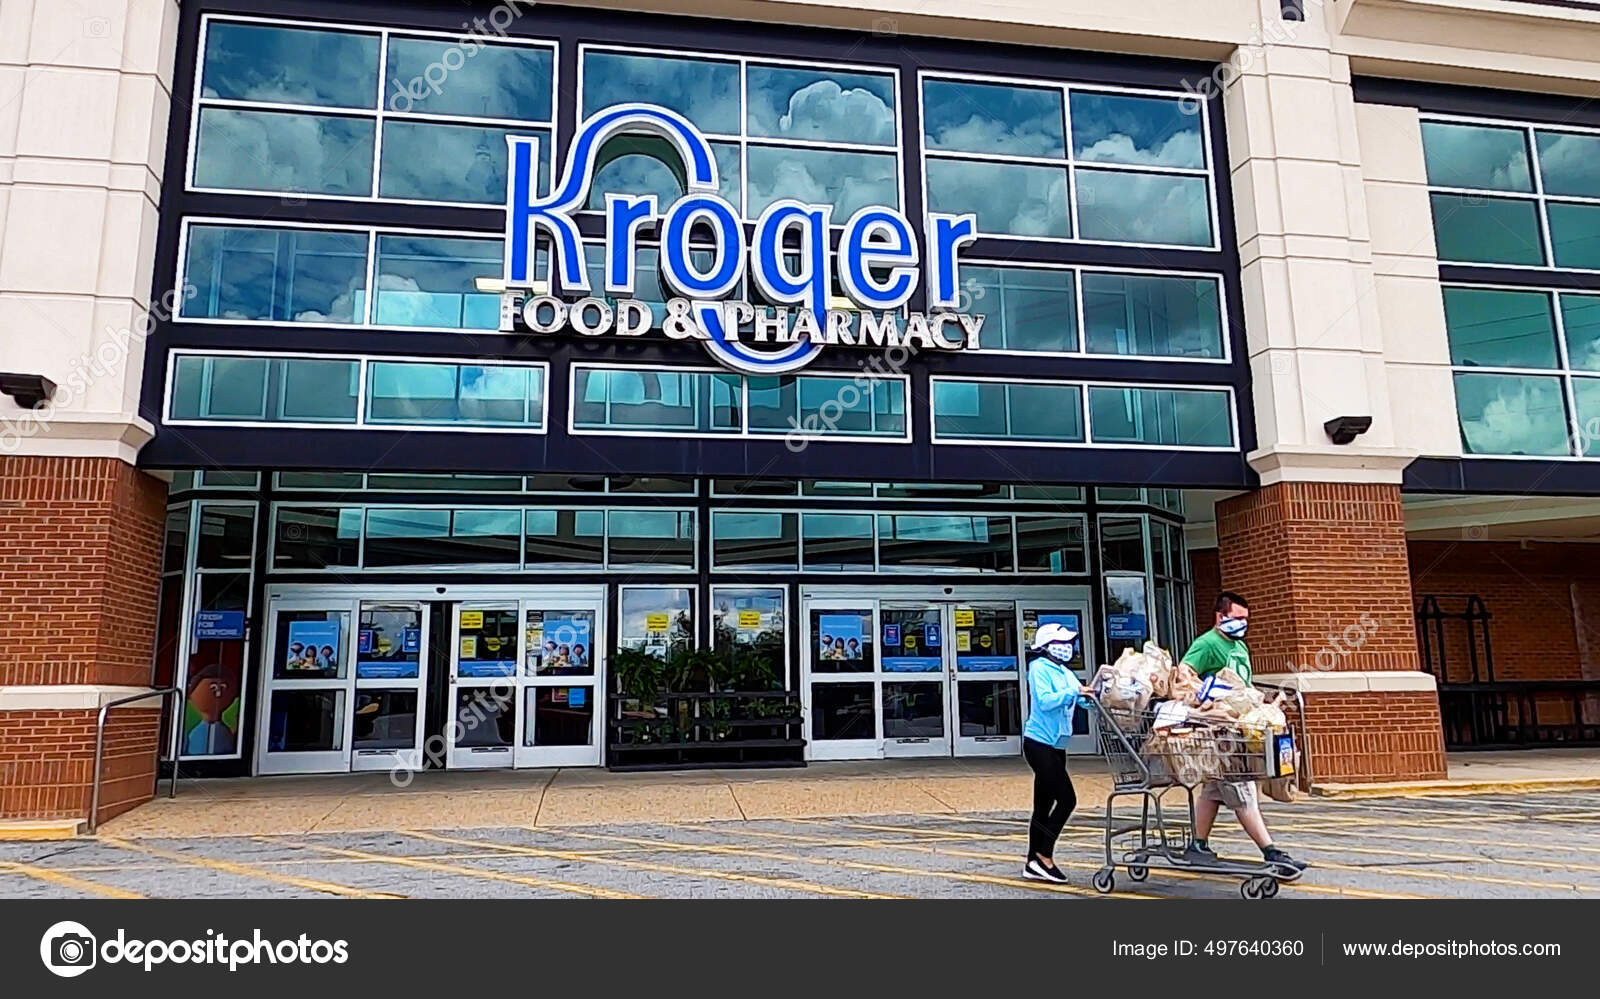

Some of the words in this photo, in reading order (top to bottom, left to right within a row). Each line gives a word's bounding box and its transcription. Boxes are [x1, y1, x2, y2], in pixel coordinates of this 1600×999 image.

[499, 291, 653, 336] FOOD
[662, 296, 702, 341] &
[723, 299, 986, 350] PHARMACY
[505, 103, 978, 374] Kroger
